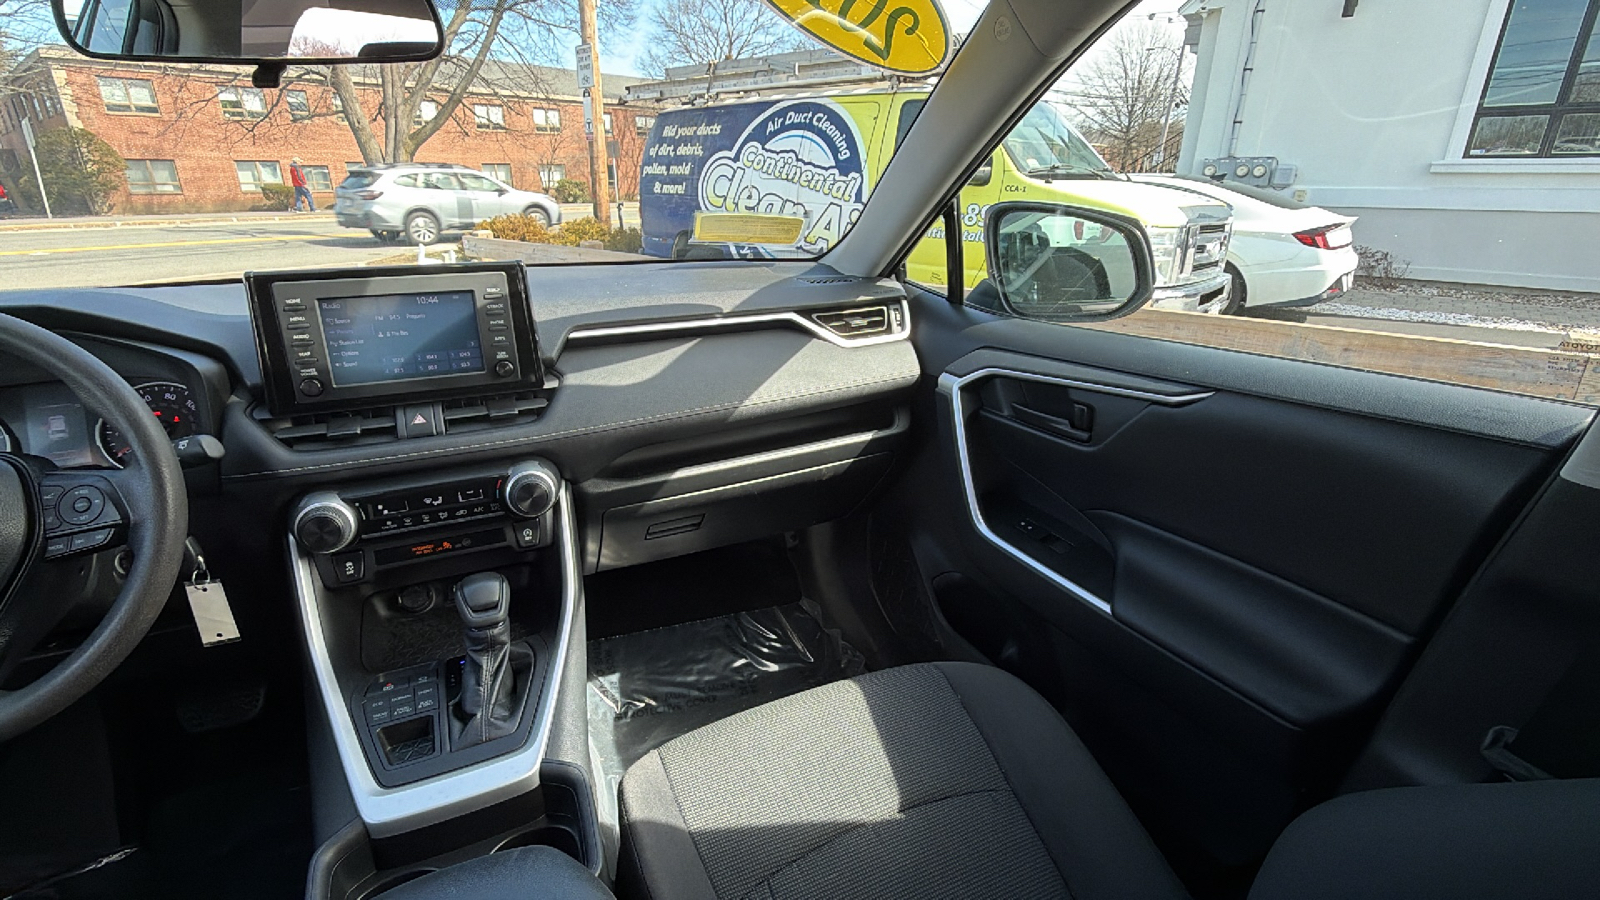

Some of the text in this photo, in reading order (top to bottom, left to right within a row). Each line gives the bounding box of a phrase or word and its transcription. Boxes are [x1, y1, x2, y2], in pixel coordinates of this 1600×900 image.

[662, 122, 722, 139] Rid your ducts
[766, 111, 851, 161] Air Duct Cleaning
[649, 142, 704, 158] of dirt, debris,
[642, 162, 691, 177] pollen, mold
[742, 144, 860, 202] Continental
[653, 181, 686, 194] & more!
[1004, 185, 1027, 193] CCA-1
[416, 296, 439, 304] 10:44
